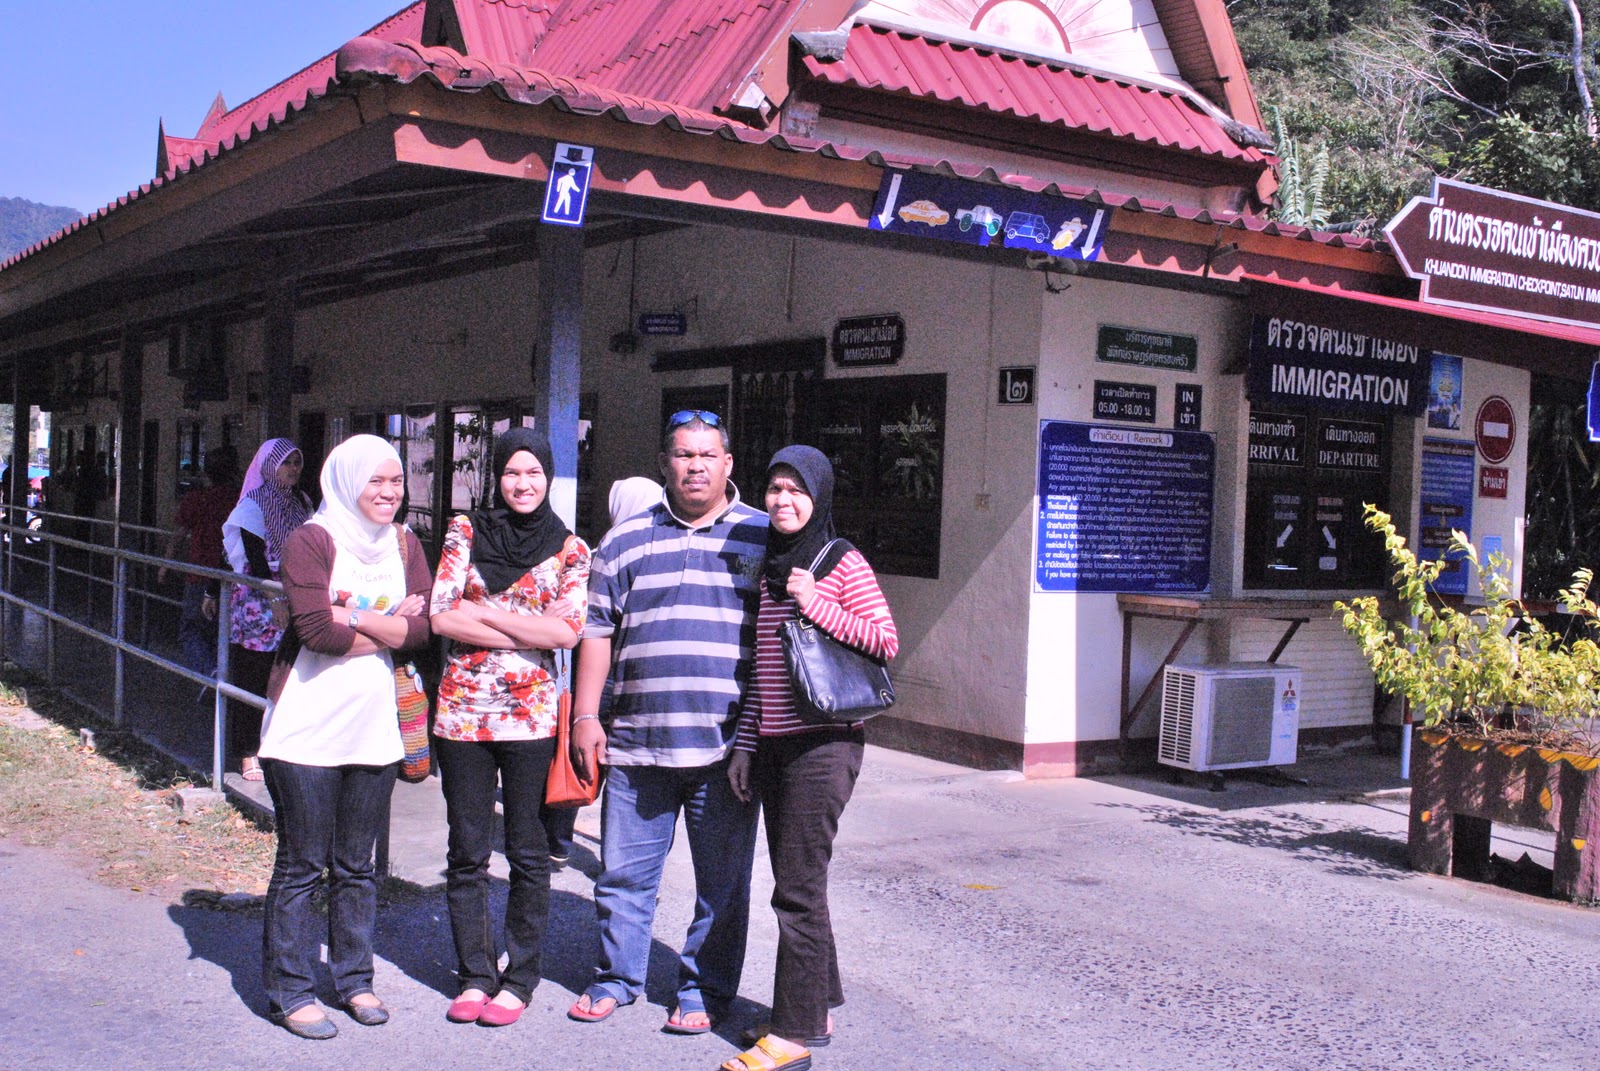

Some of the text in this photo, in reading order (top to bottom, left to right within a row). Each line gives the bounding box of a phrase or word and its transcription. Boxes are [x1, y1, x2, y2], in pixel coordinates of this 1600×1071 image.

[1424, 258, 1470, 281] KHUANDON
[1470, 266, 1518, 290] IMMIGRATION
[844, 346, 892, 361] IMMIGRATION
[1271, 364, 1409, 406] IMMIGRATION
[1101, 387, 1151, 400] เวลาเปิดทำการ
[1182, 391, 1194, 403] IN
[1098, 403, 1119, 415] 05.00
[1180, 406, 1196, 425] เข้า
[1250, 417, 1296, 438] ดินทางเข้า
[1325, 425, 1376, 445] เดินทางออก
[1093, 430, 1124, 441] คำเตือน
[1134, 433, 1163, 445] Remark
[1250, 445, 1299, 462] RRIVAL
[1319, 450, 1380, 468] DEPARTURE
[1046, 530, 1062, 539] Failure
[1050, 572, 1058, 580] you
